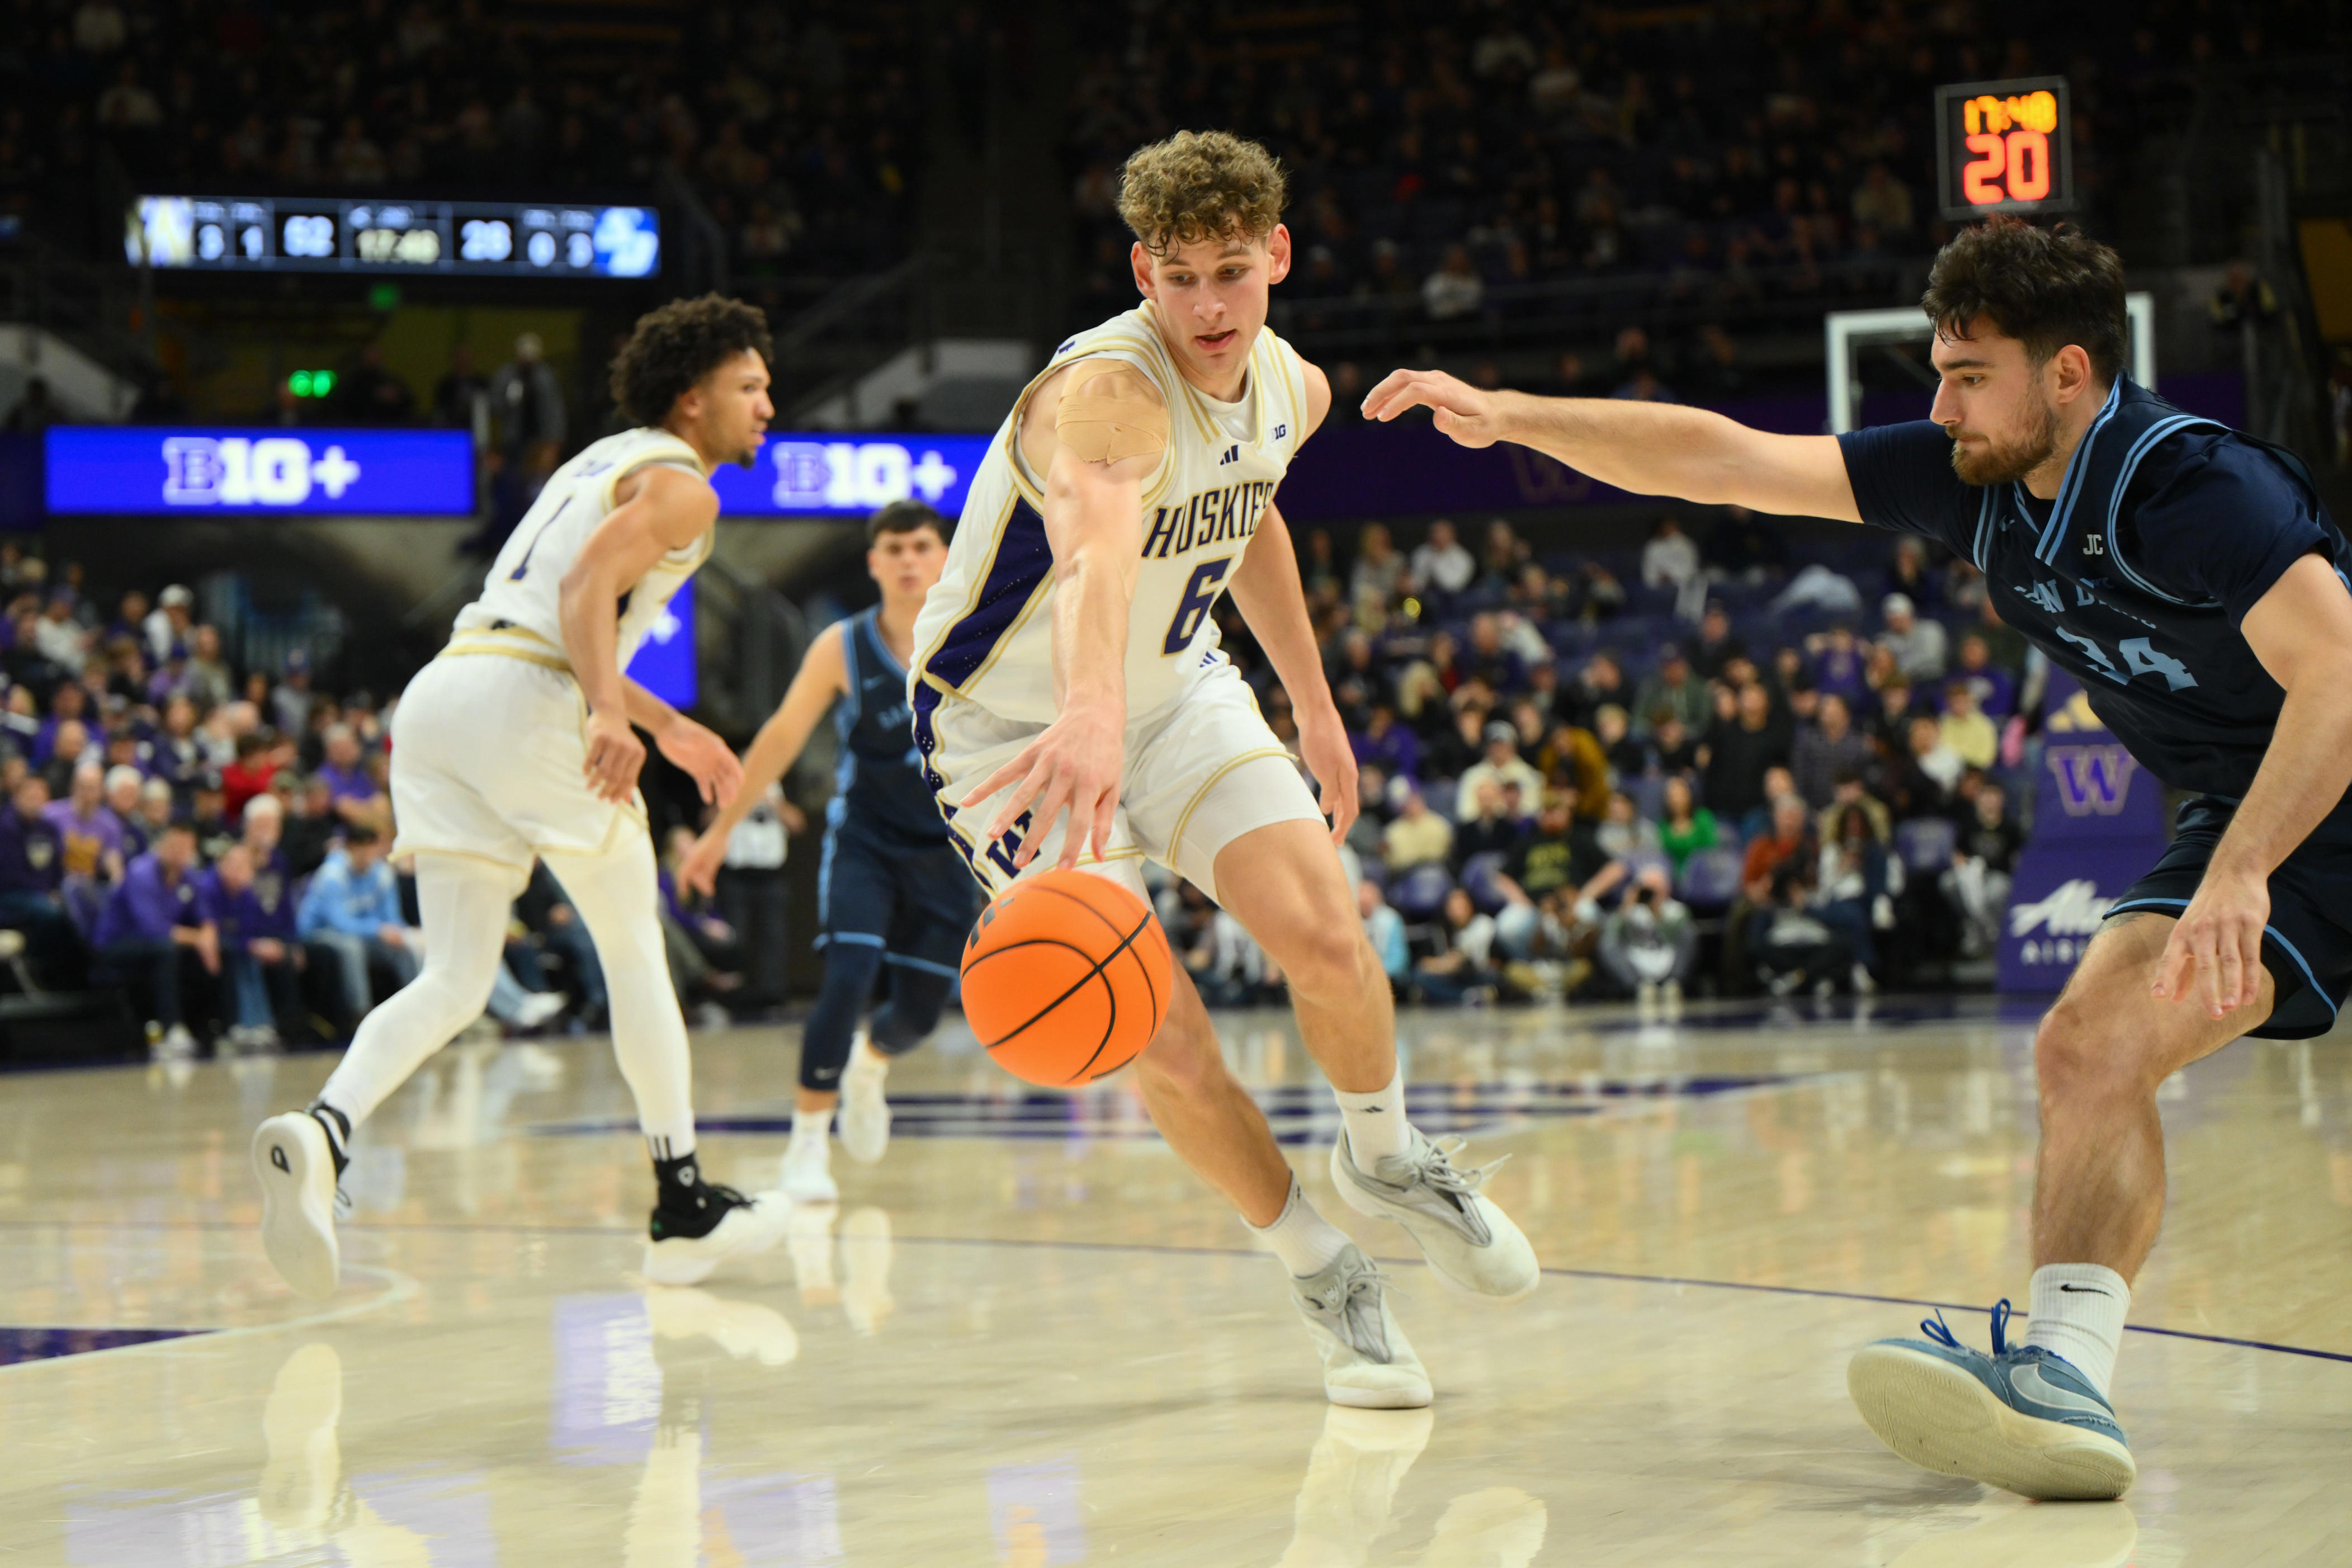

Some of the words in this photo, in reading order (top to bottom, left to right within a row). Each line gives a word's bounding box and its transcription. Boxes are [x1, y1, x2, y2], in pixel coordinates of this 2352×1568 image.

[1964, 130, 2049, 205] 20
[506, 493, 574, 583] 1
[2083, 533, 2103, 555] JC
[1160, 553, 1236, 658] 6
[2047, 744, 2139, 816] W
